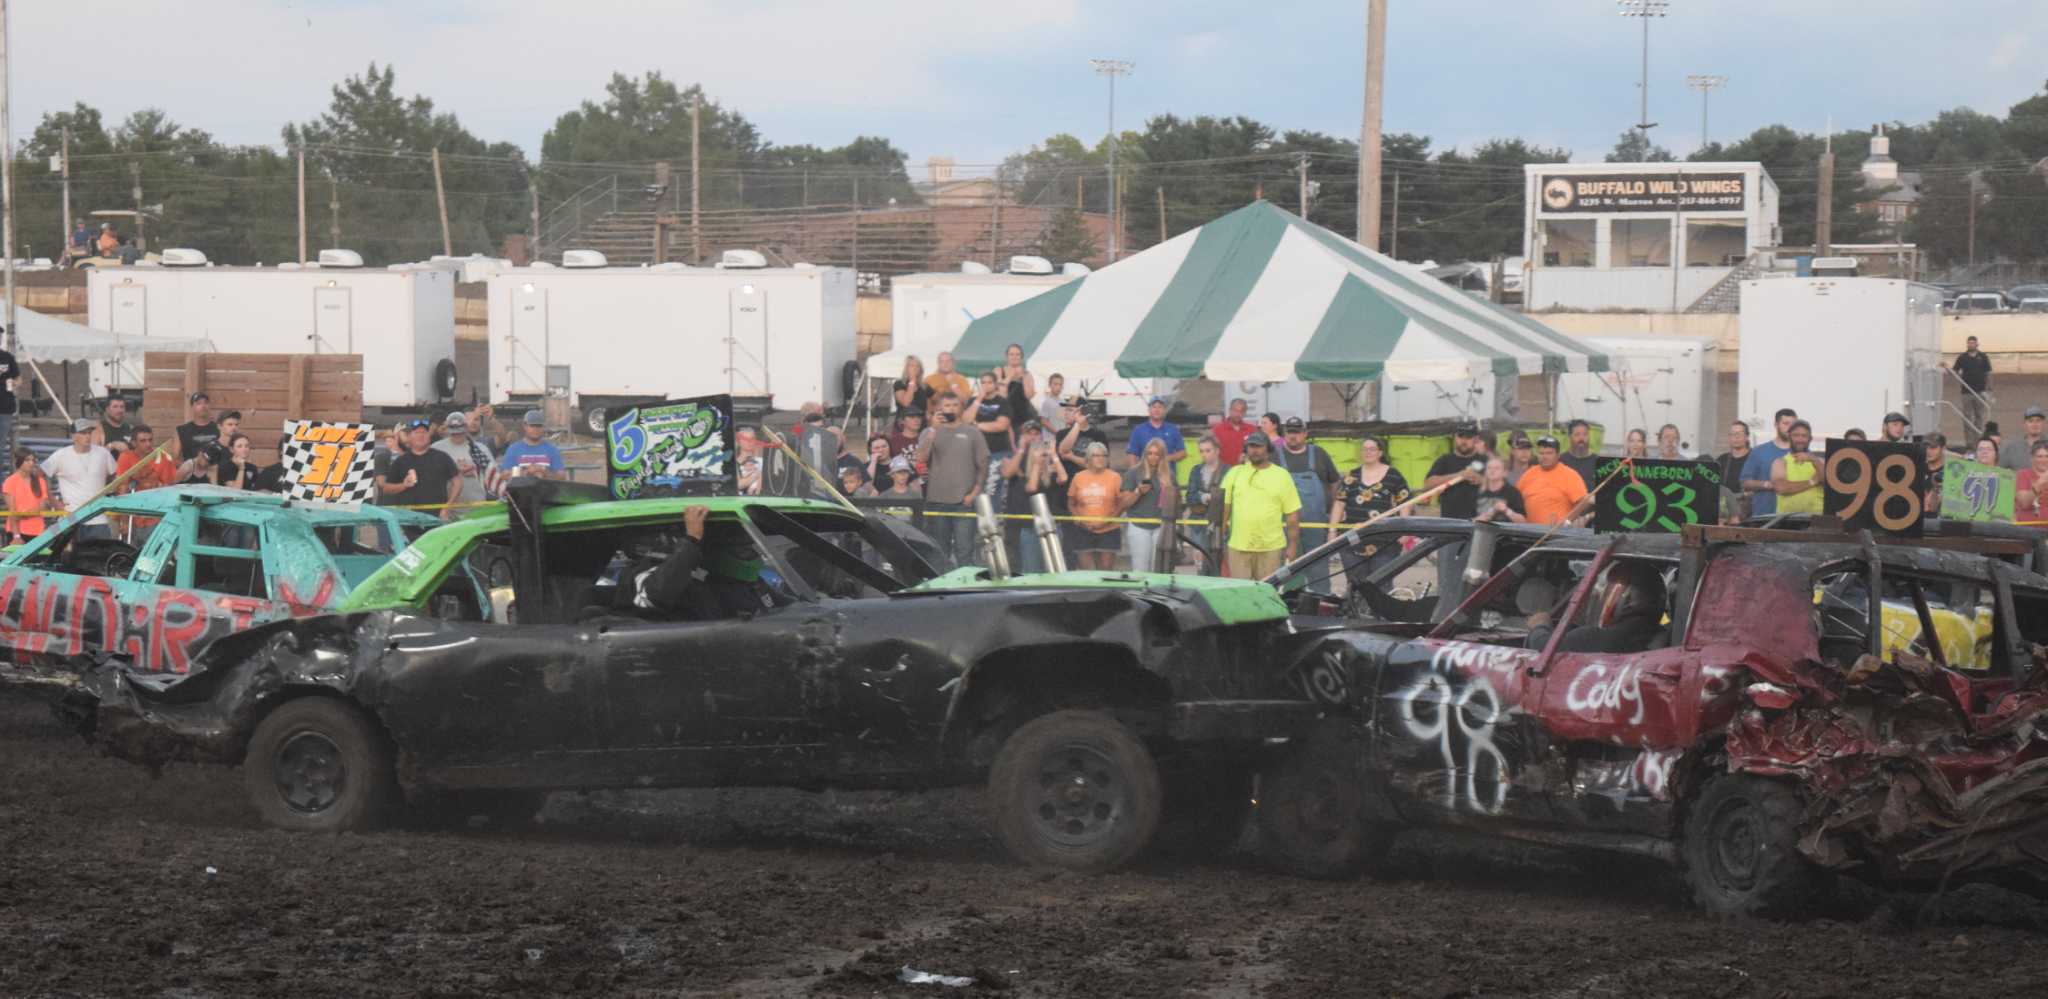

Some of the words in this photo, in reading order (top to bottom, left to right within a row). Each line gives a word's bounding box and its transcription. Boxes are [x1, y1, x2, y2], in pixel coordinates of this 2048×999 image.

[1577, 181, 1645, 196] BUFFALO
[1650, 180, 1687, 195] WILD
[1691, 179, 1741, 194] WINGS
[297, 444, 356, 486] 31
[608, 407, 647, 468] 5
[1616, 482, 1698, 532] 93
[1827, 448, 1921, 531] 98
[1566, 663, 1643, 726] Cody
[1401, 672, 1509, 815] 98
